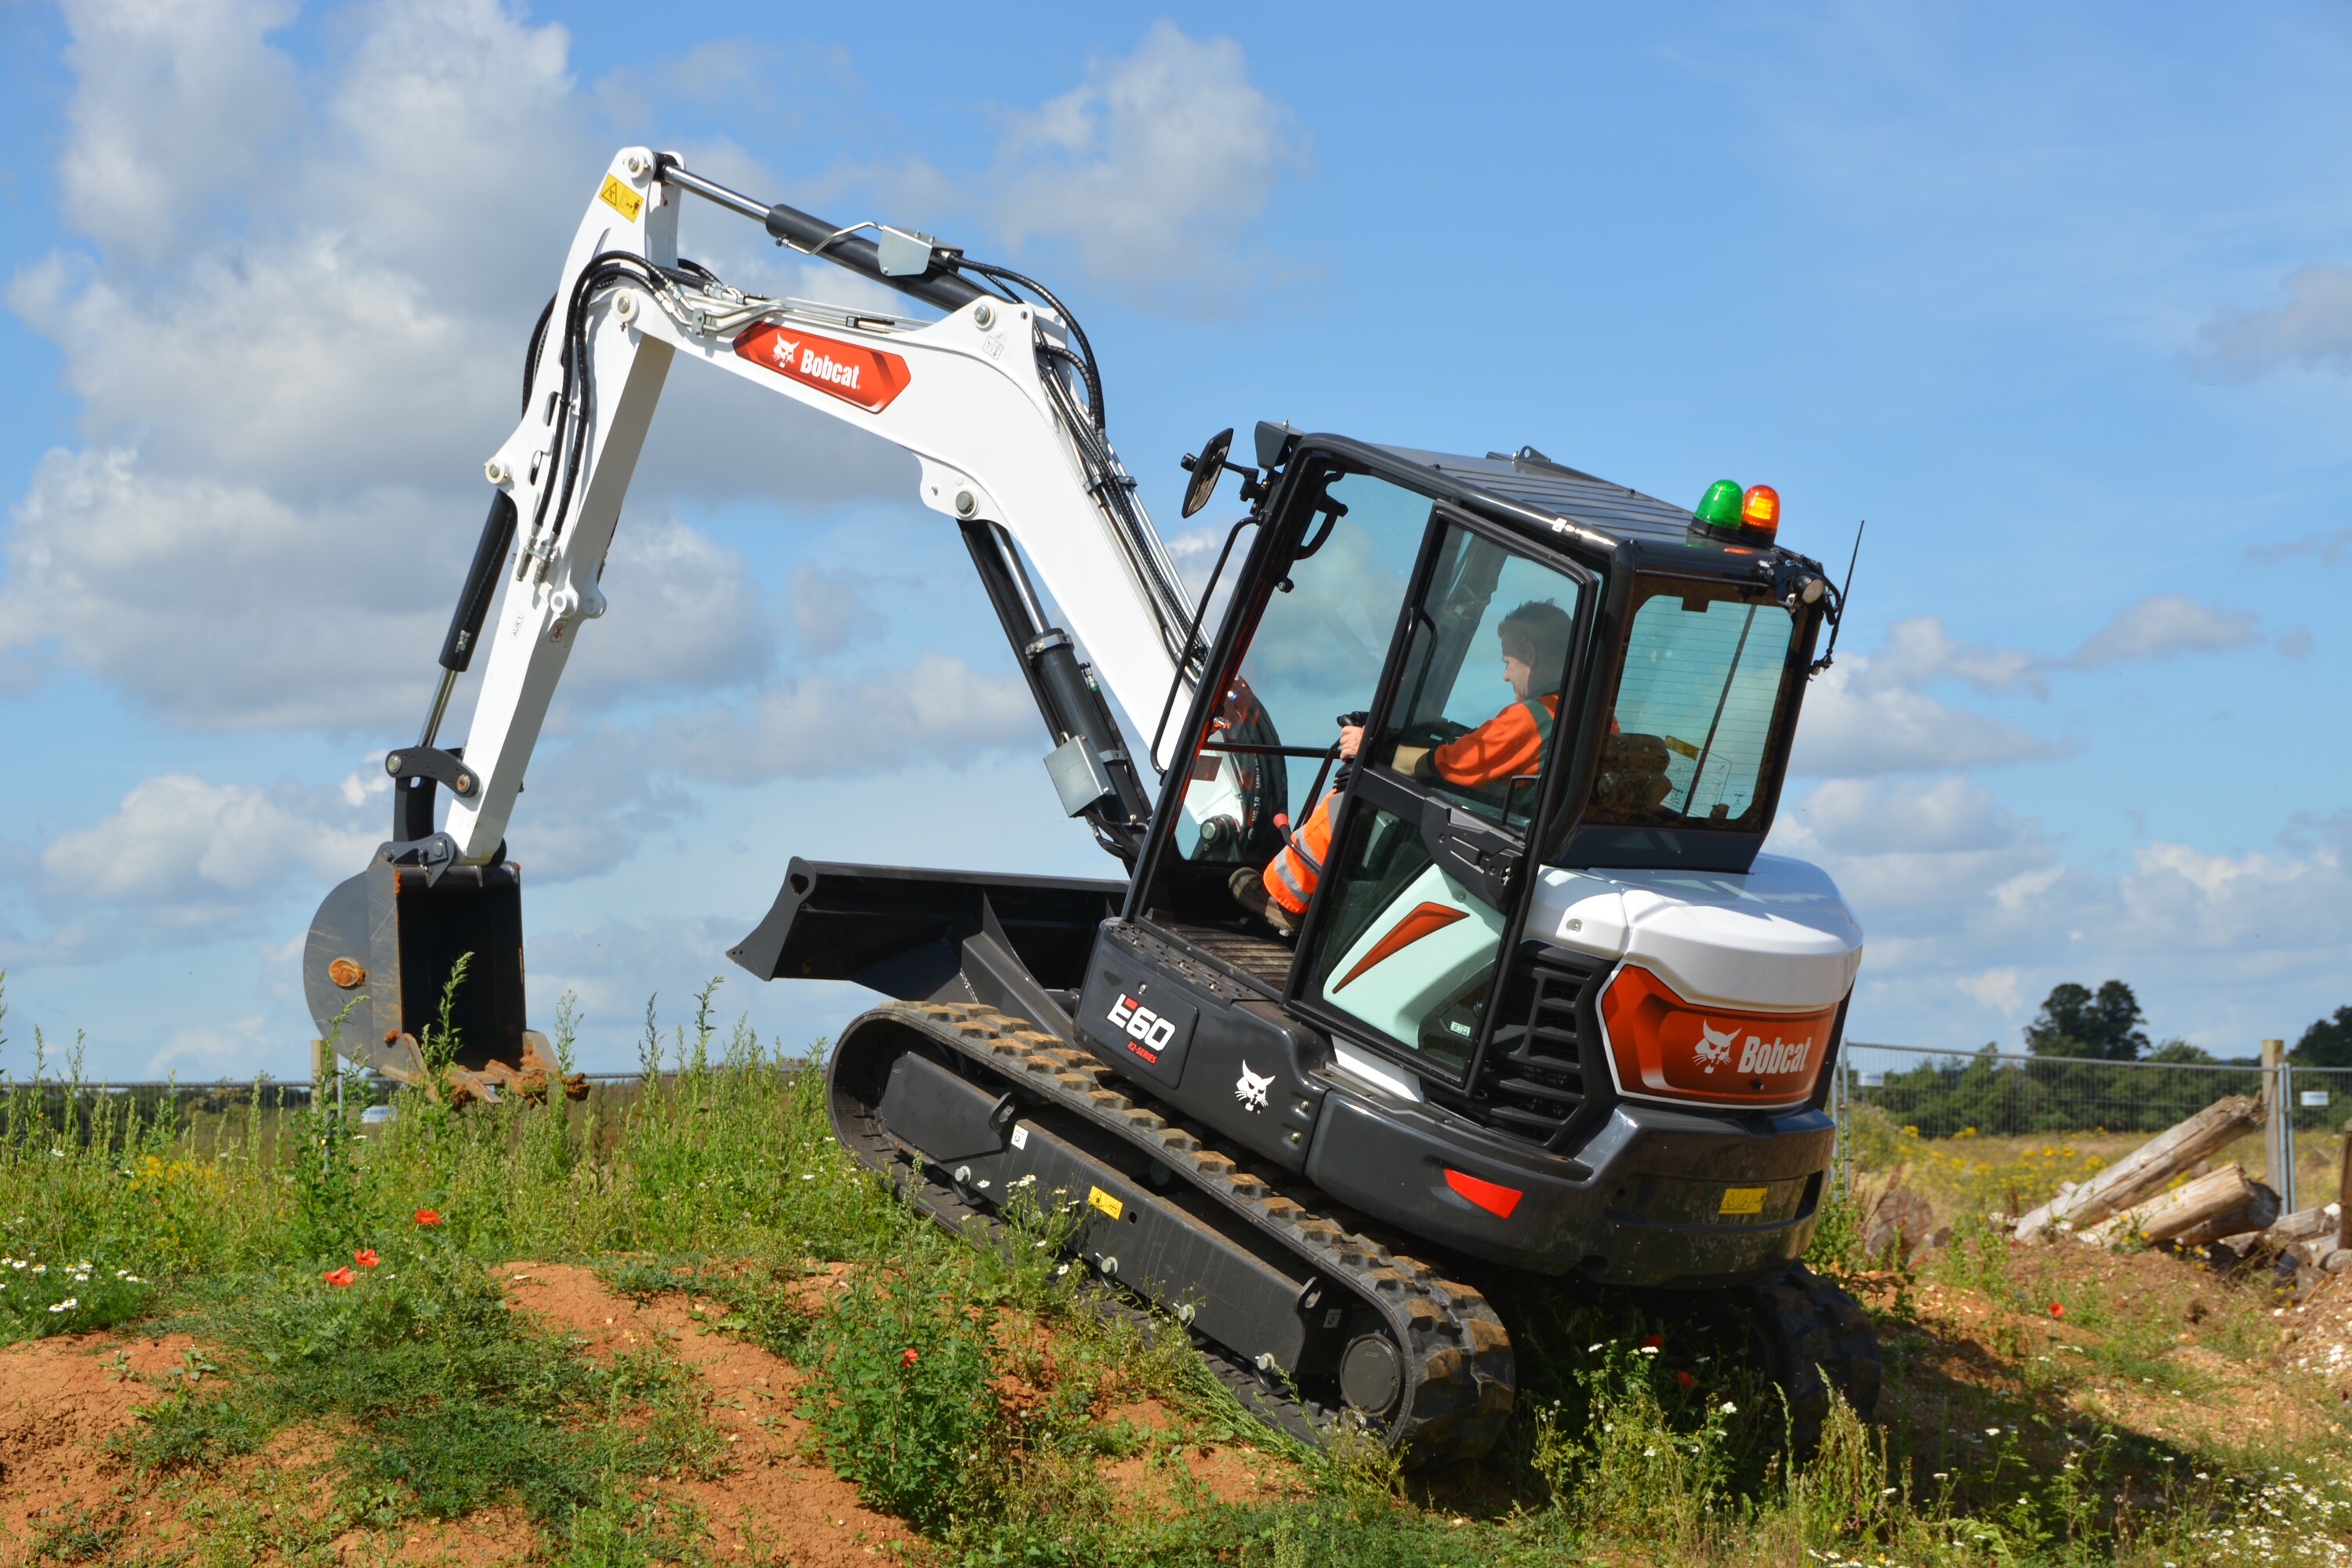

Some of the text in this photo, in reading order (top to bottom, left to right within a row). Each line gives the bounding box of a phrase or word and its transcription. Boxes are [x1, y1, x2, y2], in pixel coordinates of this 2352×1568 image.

[800, 348, 860, 390] Bobcat
[1106, 993, 1176, 1051] E60
[1127, 1041, 1158, 1064] R2-SERIES
[1737, 1036, 1812, 1074] Bobcat
